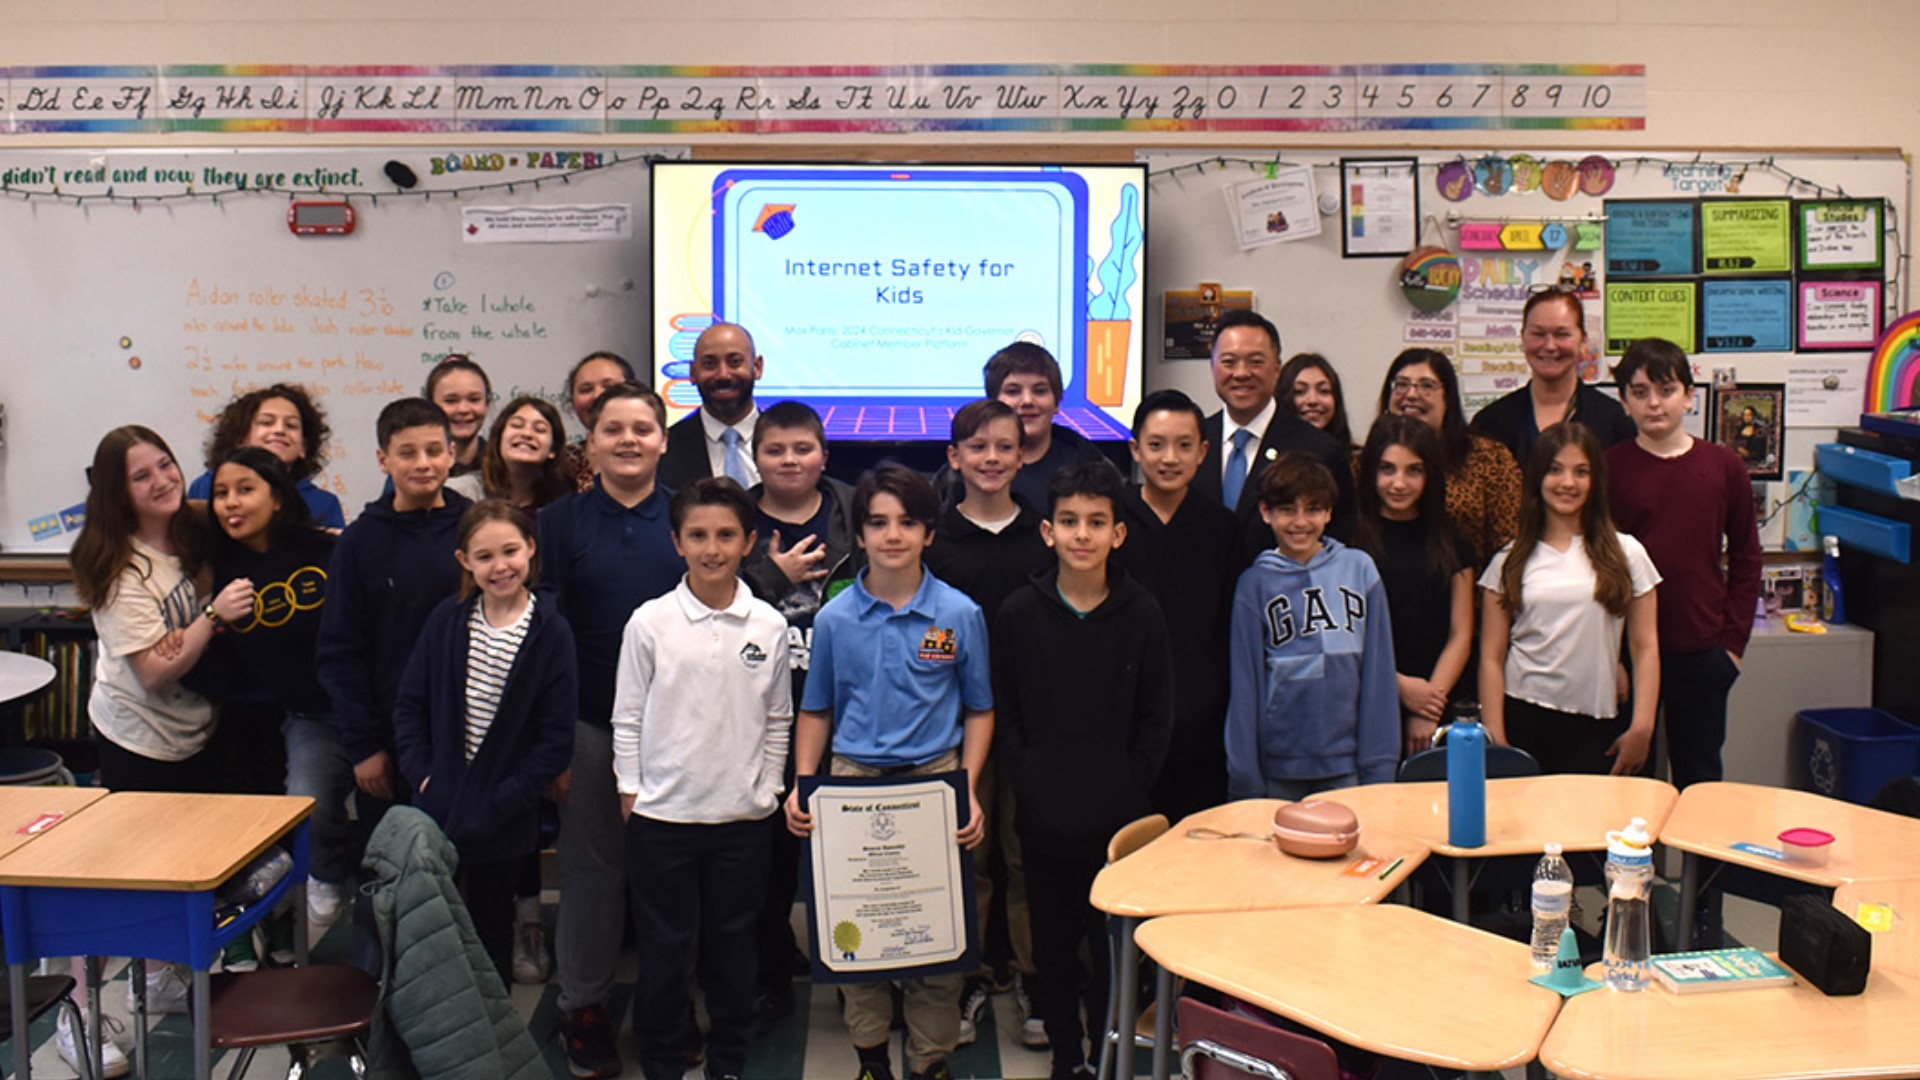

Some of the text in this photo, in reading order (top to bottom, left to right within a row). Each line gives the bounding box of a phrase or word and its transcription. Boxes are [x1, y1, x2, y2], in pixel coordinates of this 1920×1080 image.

[1259, 86, 1269, 109] 1
[1288, 86, 1305, 109] 2
[1322, 86, 1342, 109] 3
[1361, 85, 1379, 108] 4
[1398, 85, 1416, 108] 5
[1436, 85, 1453, 108] 6
[1471, 85, 1490, 108] 7
[1511, 85, 1529, 108] 8
[1544, 85, 1562, 108] 9
[1582, 85, 1611, 108] 10
[430, 153, 505, 176] BOARD
[3, 166, 363, 190] didn't read and now they are extinct.
[1672, 177, 1723, 192] Target
[1712, 208, 1779, 221] SUMMARIZING
[785, 258, 1015, 282] Internet Safety for
[1462, 257, 1541, 286] DAILY
[876, 286, 924, 305] Kids
[1611, 289, 1686, 303] CONTEXT CLUES
[1821, 288, 1860, 298] Science
[490, 294, 536, 313] whole
[470, 322, 495, 341] the
[501, 321, 548, 340] whole
[965, 325, 1014, 336] Governor
[830, 338, 875, 349] Cabinet
[876, 338, 921, 349] Member
[1265, 586, 1367, 647] GAP
[842, 801, 920, 813] State of Connecticut
